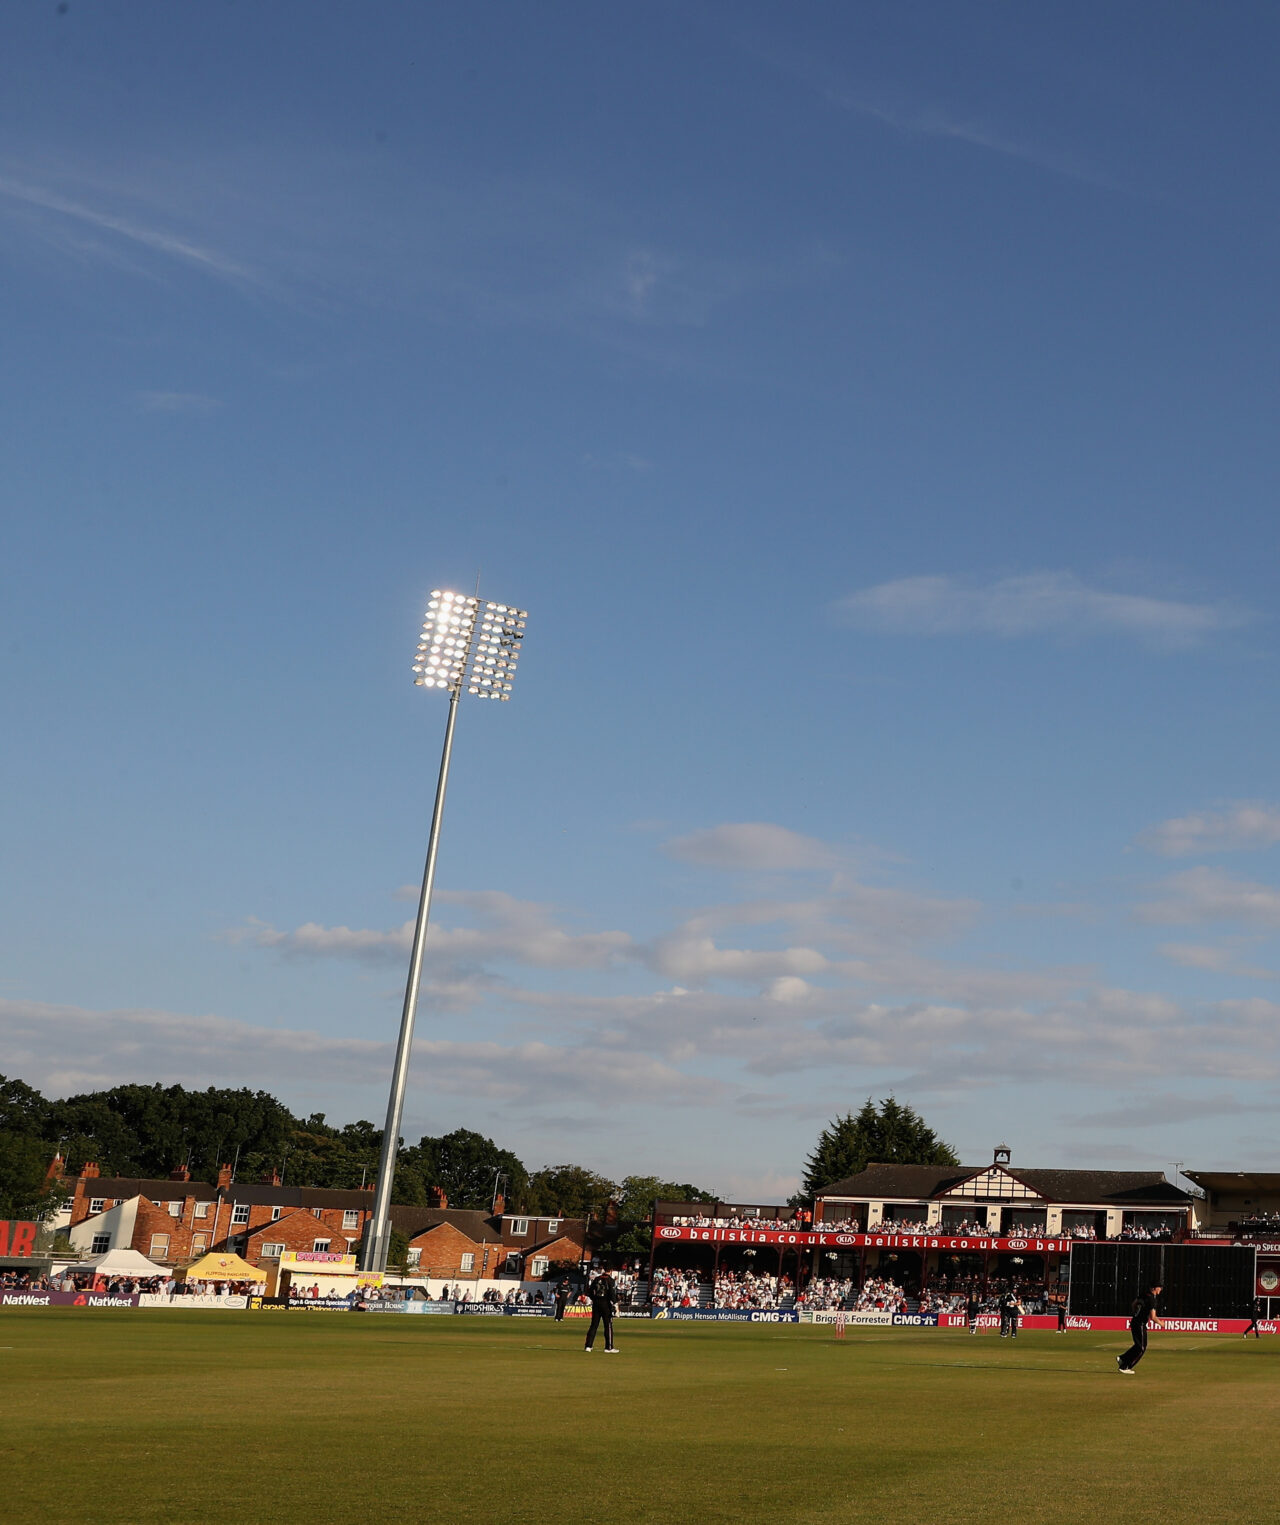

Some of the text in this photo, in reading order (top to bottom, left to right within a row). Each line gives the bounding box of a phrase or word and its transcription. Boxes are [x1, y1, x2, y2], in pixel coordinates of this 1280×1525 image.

[690, 1229, 827, 1244] bellskia.co.uk
[864, 1235, 998, 1249] bellskia.co.uk
[296, 1252, 343, 1262] SWEETS
[2, 1294, 50, 1306] NatWest
[88, 1296, 133, 1307] NatWest
[673, 1312, 693, 1320] Phipps
[718, 1313, 748, 1321] McAllister
[751, 1312, 780, 1322] CMG
[851, 1315, 889, 1323] Forrester
[893, 1315, 921, 1325] CMG
[1066, 1316, 1092, 1331] Vitality
[1164, 1319, 1218, 1331] INSURANCE
